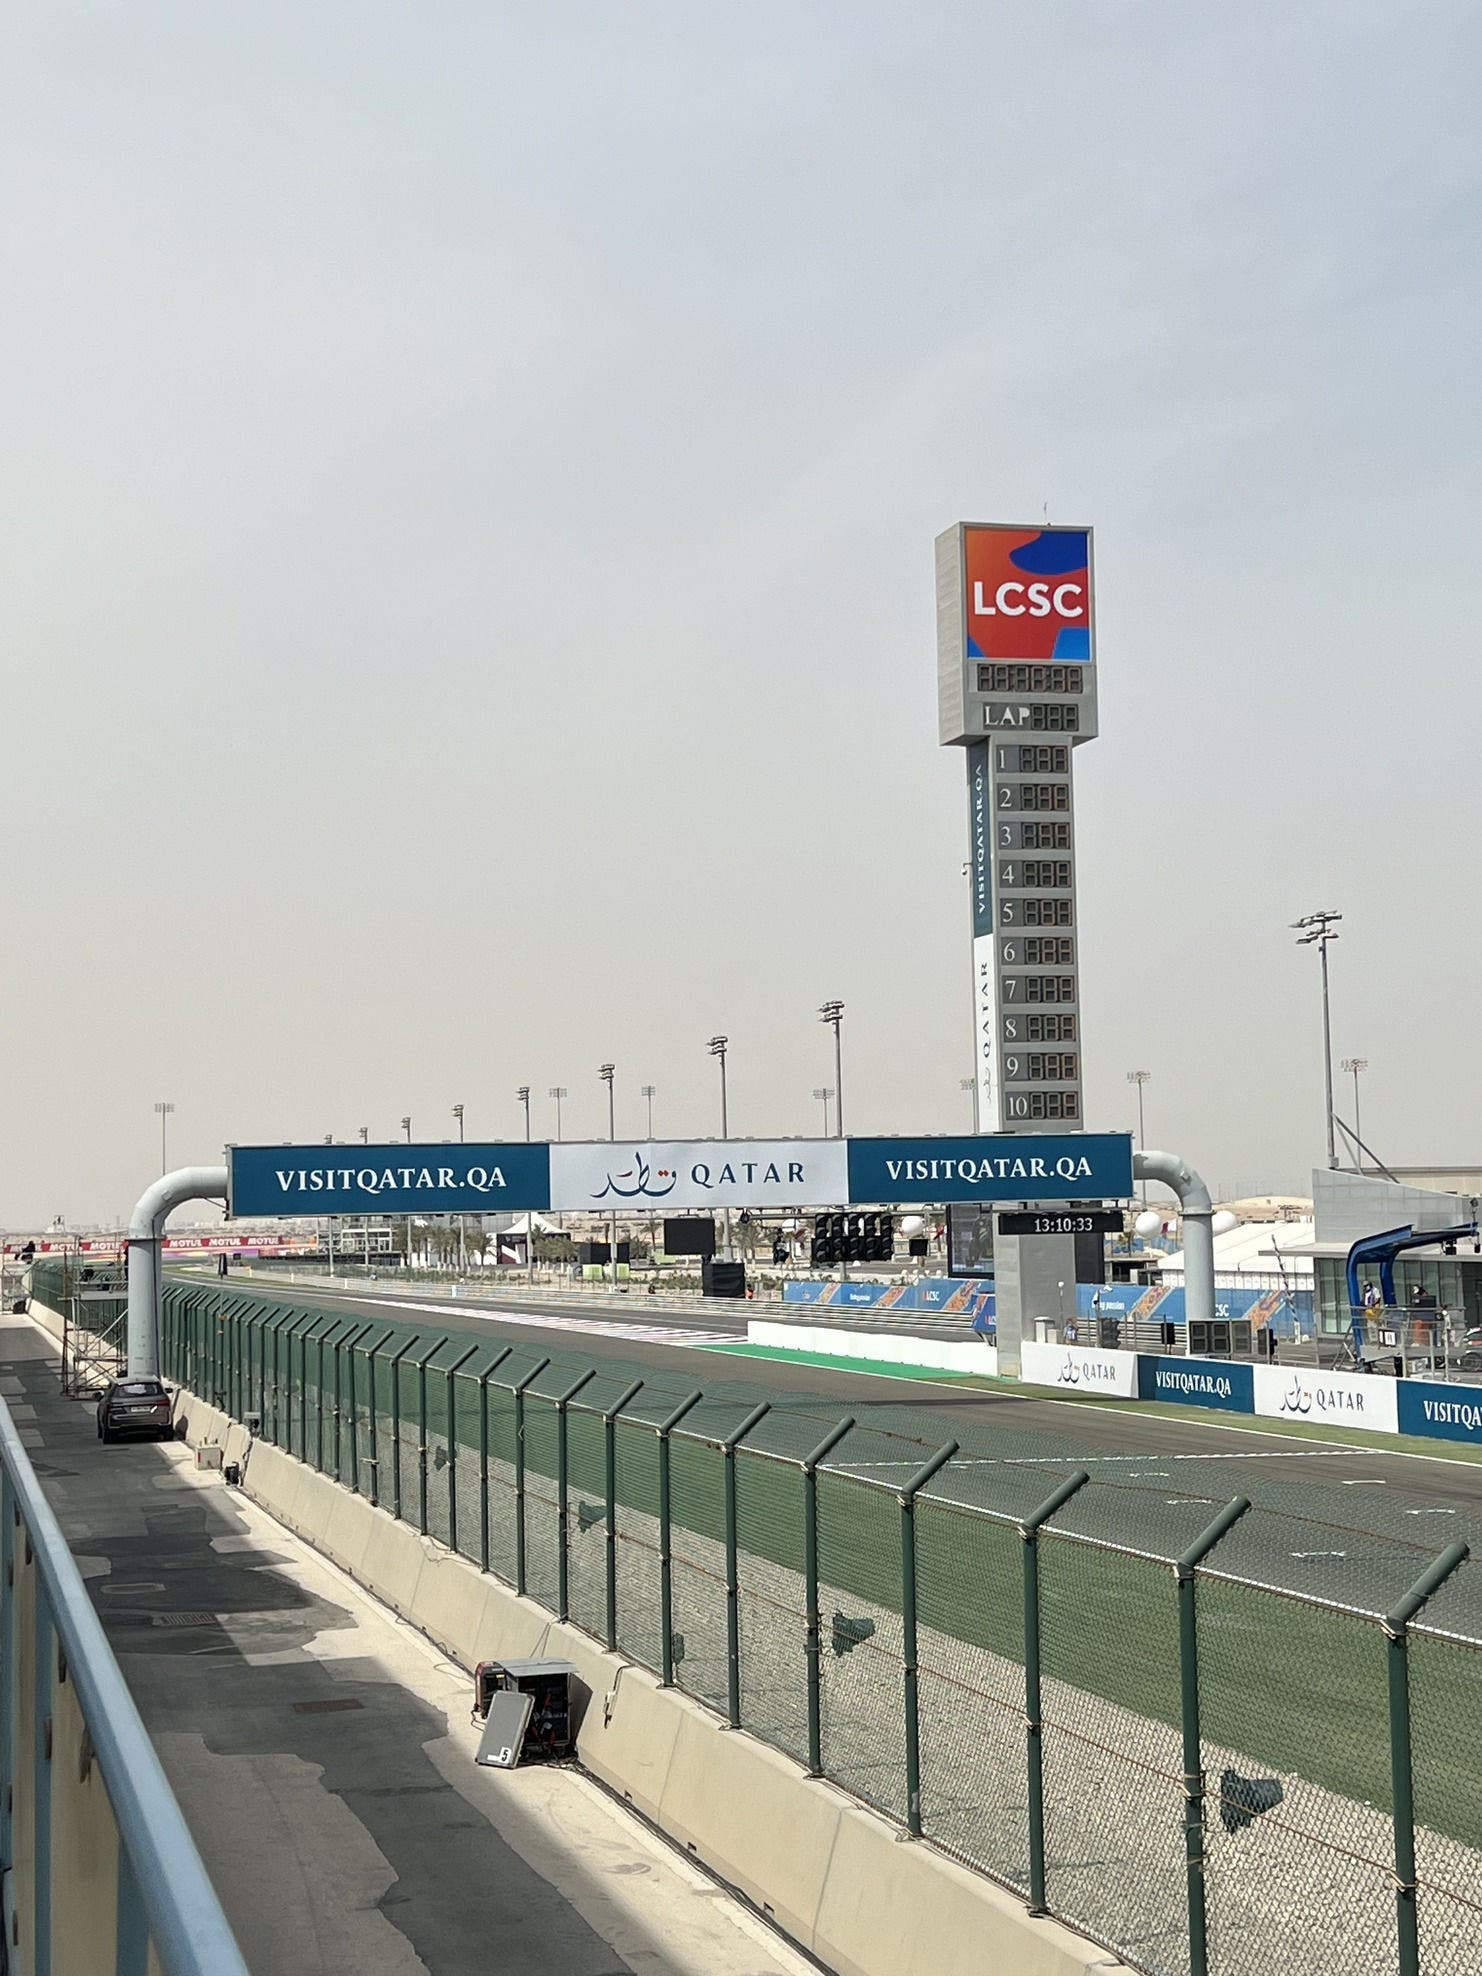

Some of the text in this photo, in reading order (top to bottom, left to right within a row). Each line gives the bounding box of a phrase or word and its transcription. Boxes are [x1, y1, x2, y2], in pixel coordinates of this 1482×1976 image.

[973, 581, 1084, 618] LCSC
[984, 705, 1031, 726] LAP
[999, 749, 1006, 769] 1
[999, 788, 1012, 808] 2
[1000, 826, 1012, 846] 3
[1002, 864, 1014, 884] 4
[1002, 903, 1014, 922] 5
[1003, 941, 1016, 962] 6
[1004, 980, 1017, 999] 7
[1005, 1018, 1017, 1038] 8
[1006, 1056, 1019, 1077] 9
[1008, 1096, 1028, 1117] 10
[691, 1162, 805, 1189] QATAR
[886, 1156, 1093, 1183] VISITQATAR.QA
[275, 1167, 507, 1195] VISITQATAR.QA
[1034, 1217, 1093, 1232] 13:10:33
[169, 1239, 202, 1248] MOTUL
[209, 1238, 241, 1246] MOTUL
[247, 1237, 280, 1245] MOTUL
[1083, 1363, 1116, 1381] QATAR
[1155, 1370, 1232, 1398] VISITQATAR.QA
[1316, 1388, 1364, 1412] QATAR
[1423, 1400, 1482, 1430] VISITQA
[501, 1749, 509, 1762] 5
